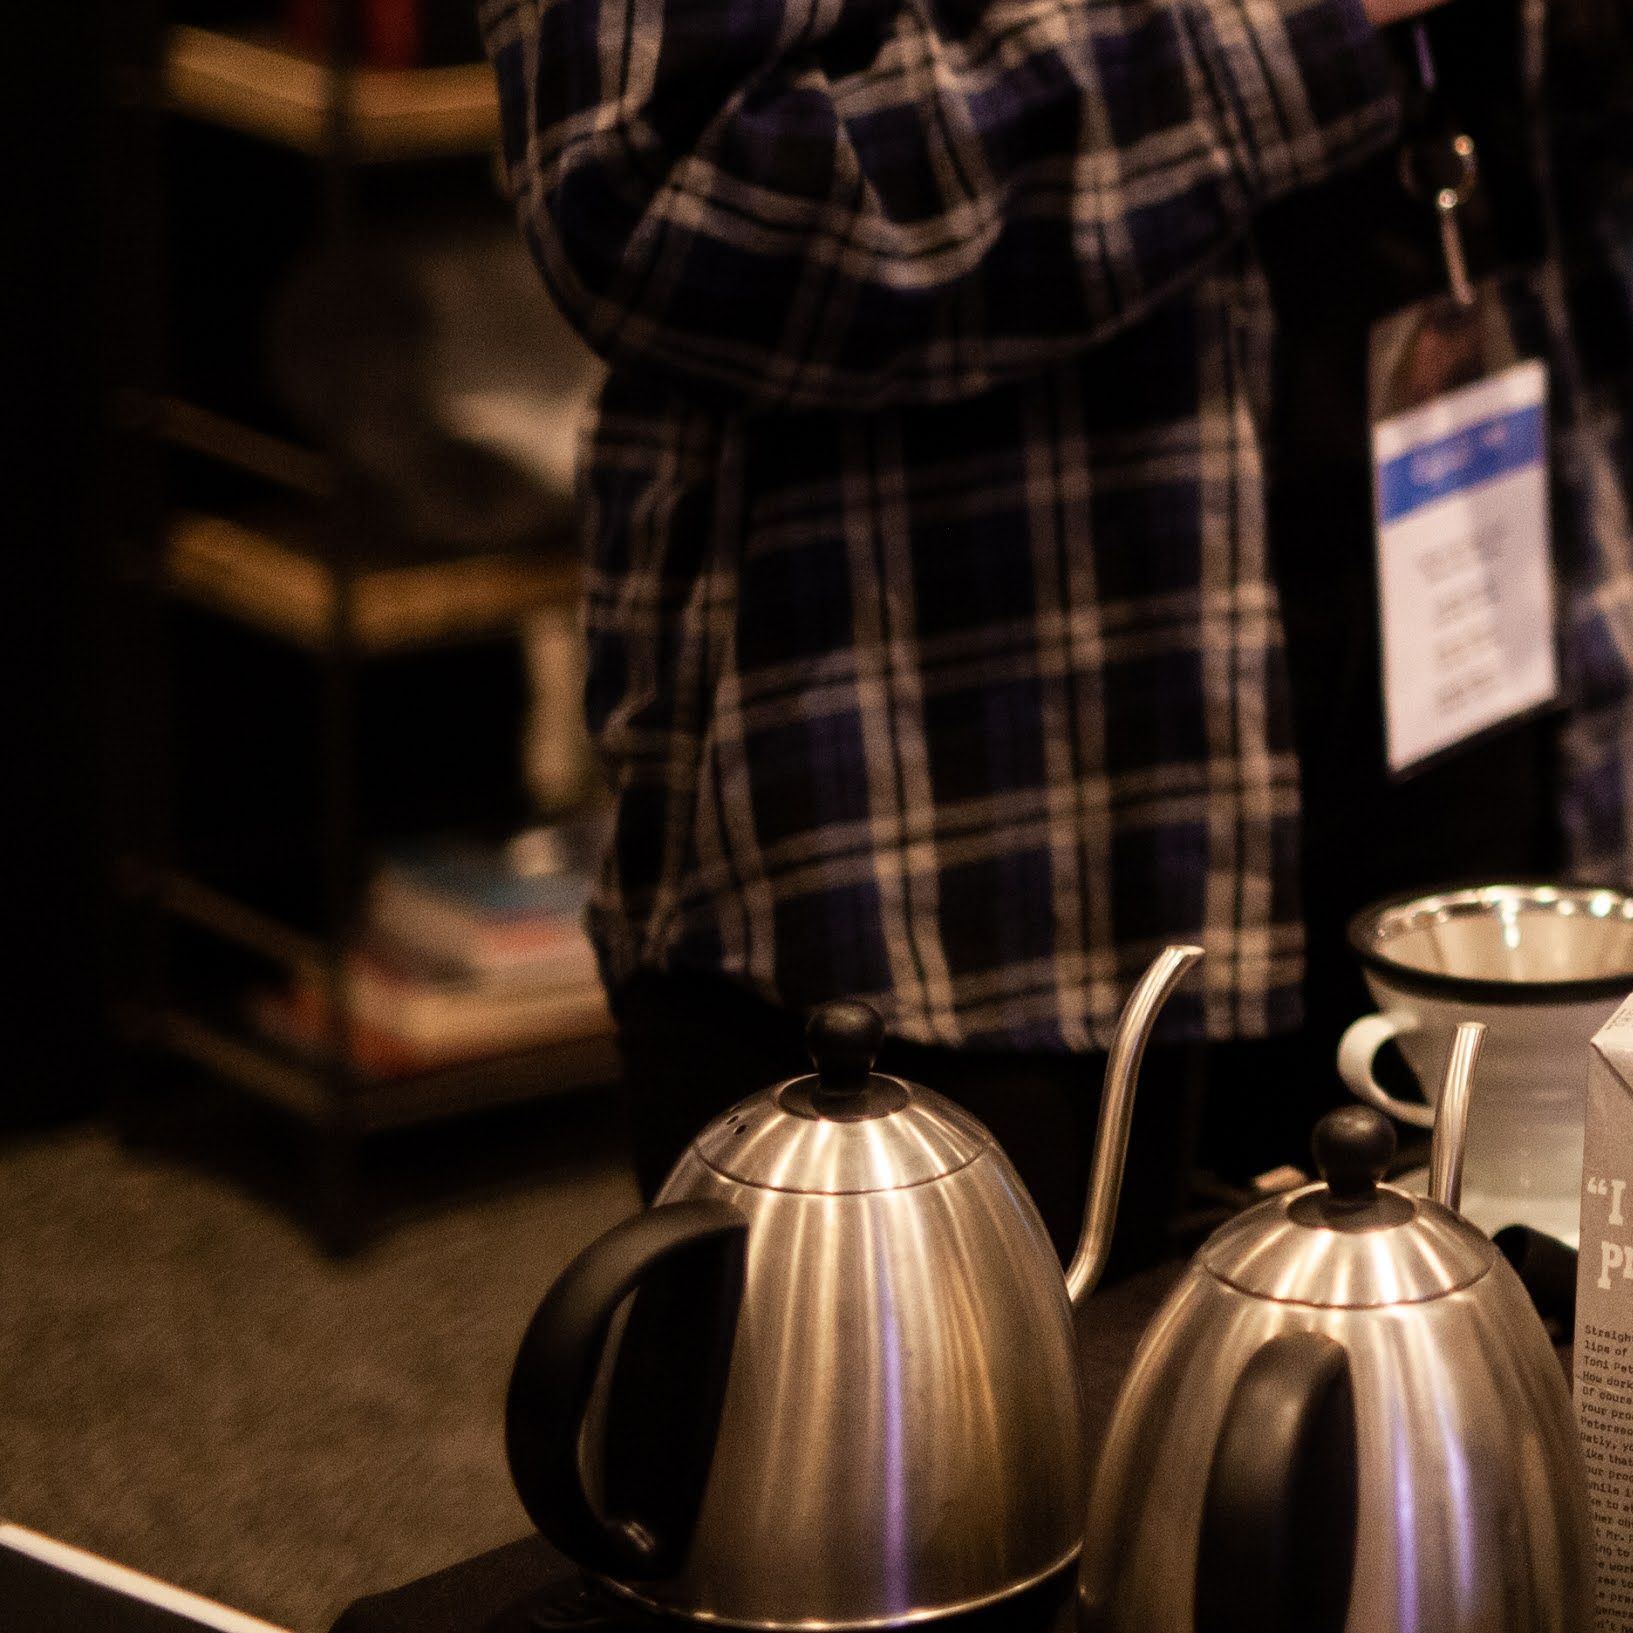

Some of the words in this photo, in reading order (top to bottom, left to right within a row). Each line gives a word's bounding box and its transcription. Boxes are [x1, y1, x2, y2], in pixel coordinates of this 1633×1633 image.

[1585, 1340, 1610, 1354] lips
[1615, 1348, 1627, 1357] of
[1584, 1355, 1609, 1370] Toni
[1583, 1371, 1602, 1384] How
[1582, 1387, 1594, 1396] Of
[1581, 1402, 1606, 1416] your
[1606, 1499, 1619, 1510] to
[1617, 1547, 1630, 1558] to
[1621, 1578, 1633, 1589] to
